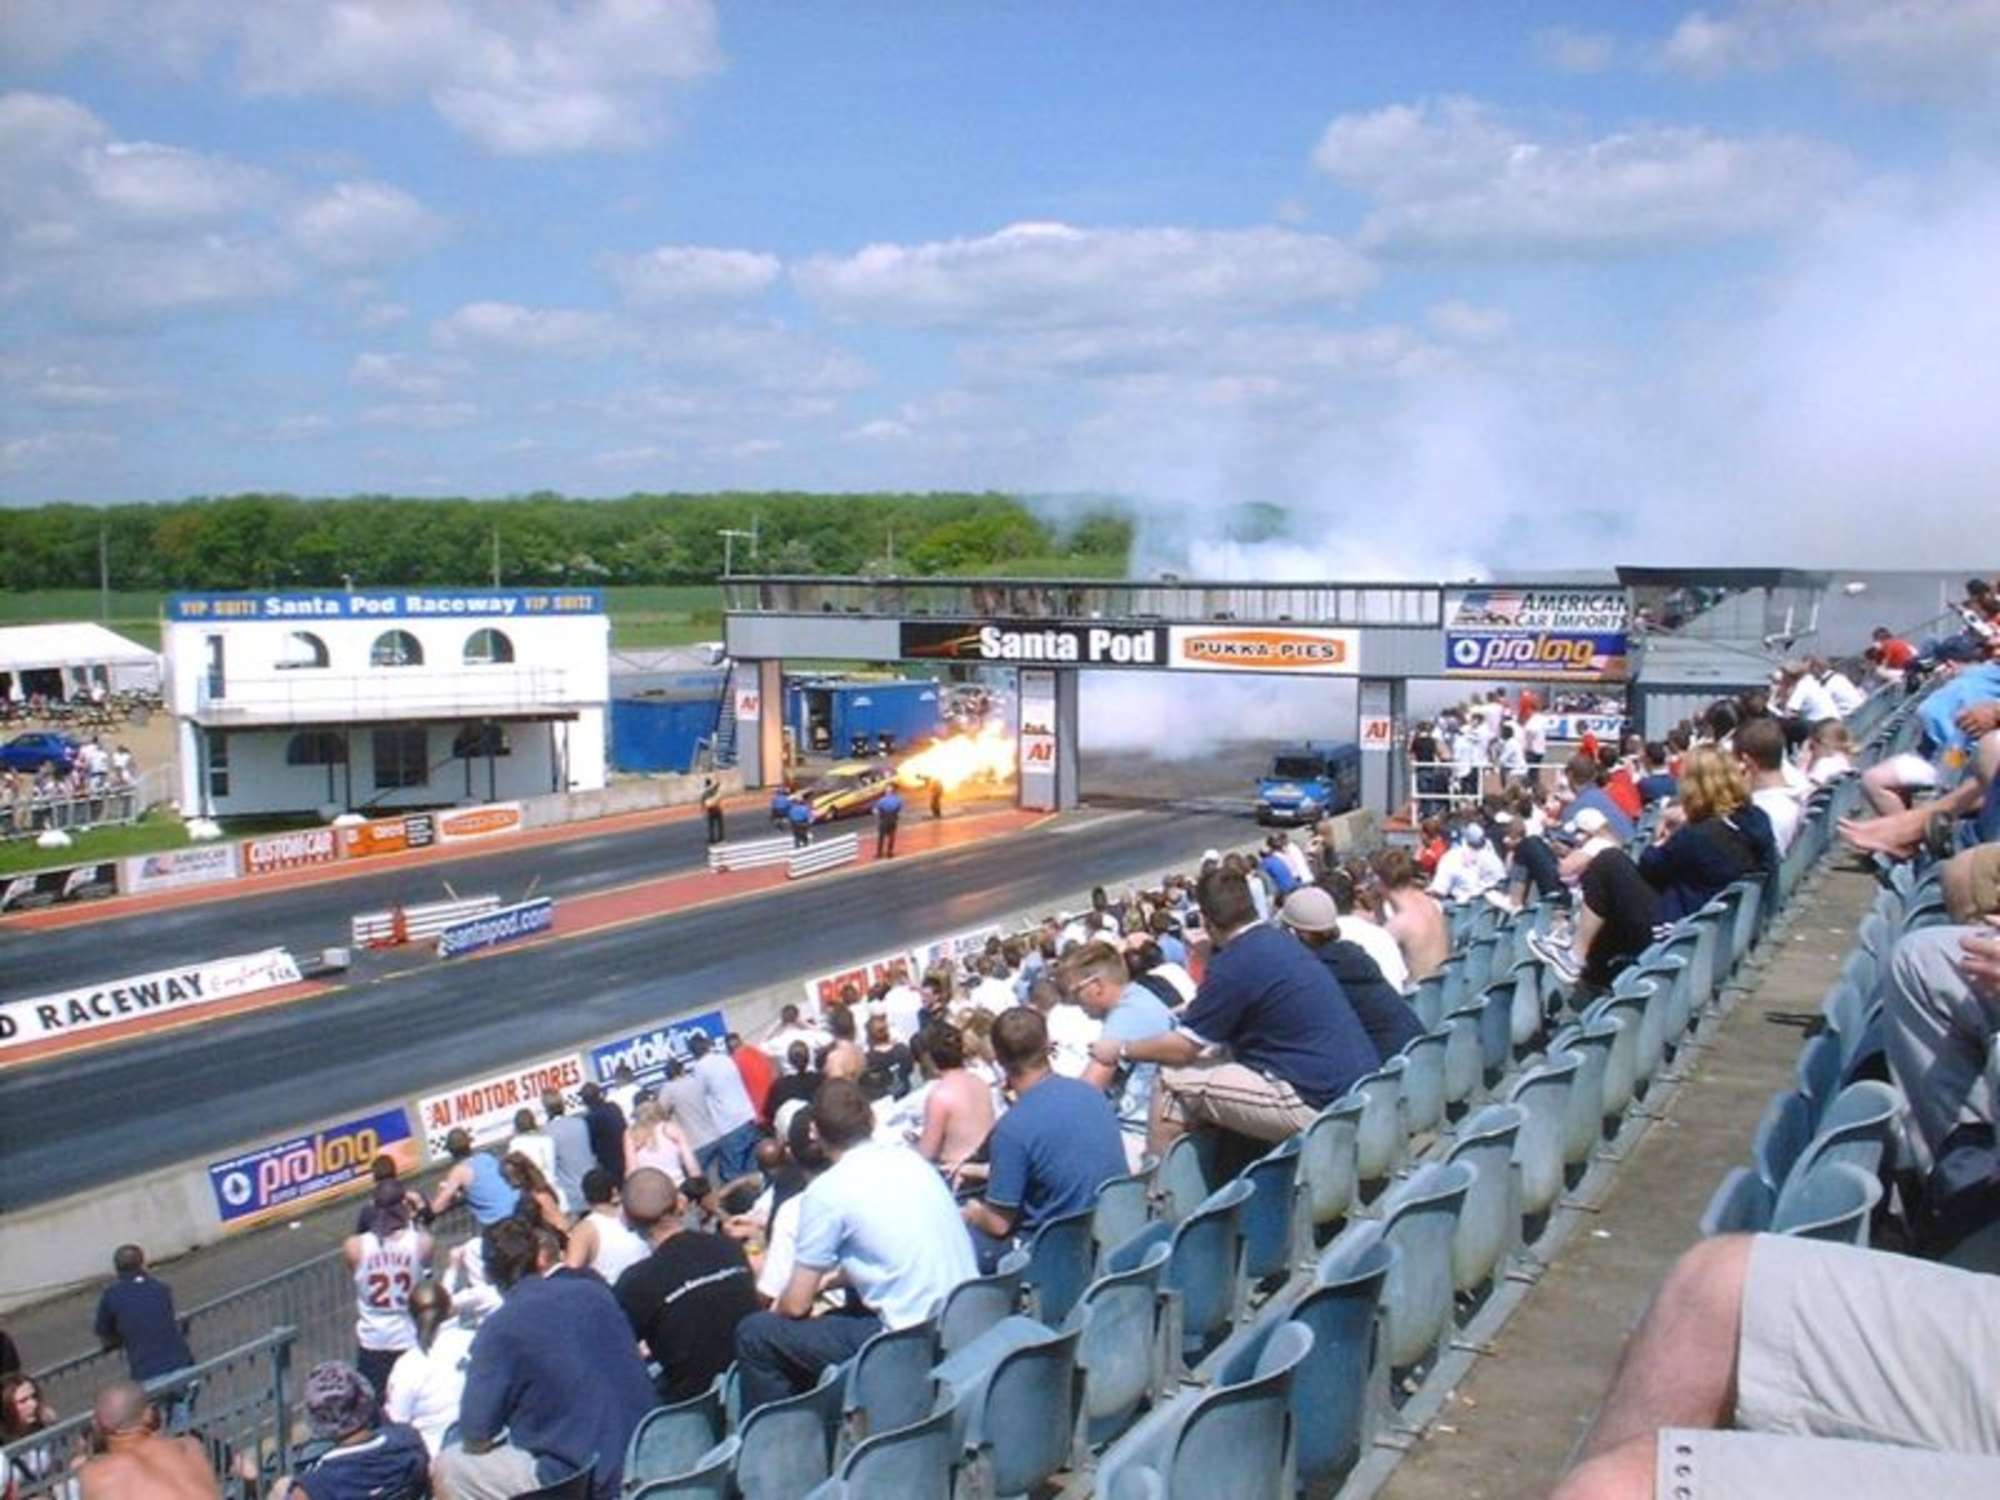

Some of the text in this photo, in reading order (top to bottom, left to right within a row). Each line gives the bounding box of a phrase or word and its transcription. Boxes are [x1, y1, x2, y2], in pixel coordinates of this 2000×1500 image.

[264, 597, 339, 615] Santa
[351, 597, 396, 613] Pod
[405, 596, 517, 614] Raceway
[1514, 613, 1548, 627] CAR
[1521, 592, 1628, 612] AMERICAN
[979, 626, 1156, 662] Santa Pod
[1482, 632, 1596, 668] prolong
[446, 905, 553, 948] santapod.com
[36, 973, 205, 1031] RACEWAY
[456, 1079, 519, 1121] MOTOR
[521, 1059, 581, 1101] STORES
[258, 1128, 378, 1205] prolong
[367, 1272, 411, 1308] 23
